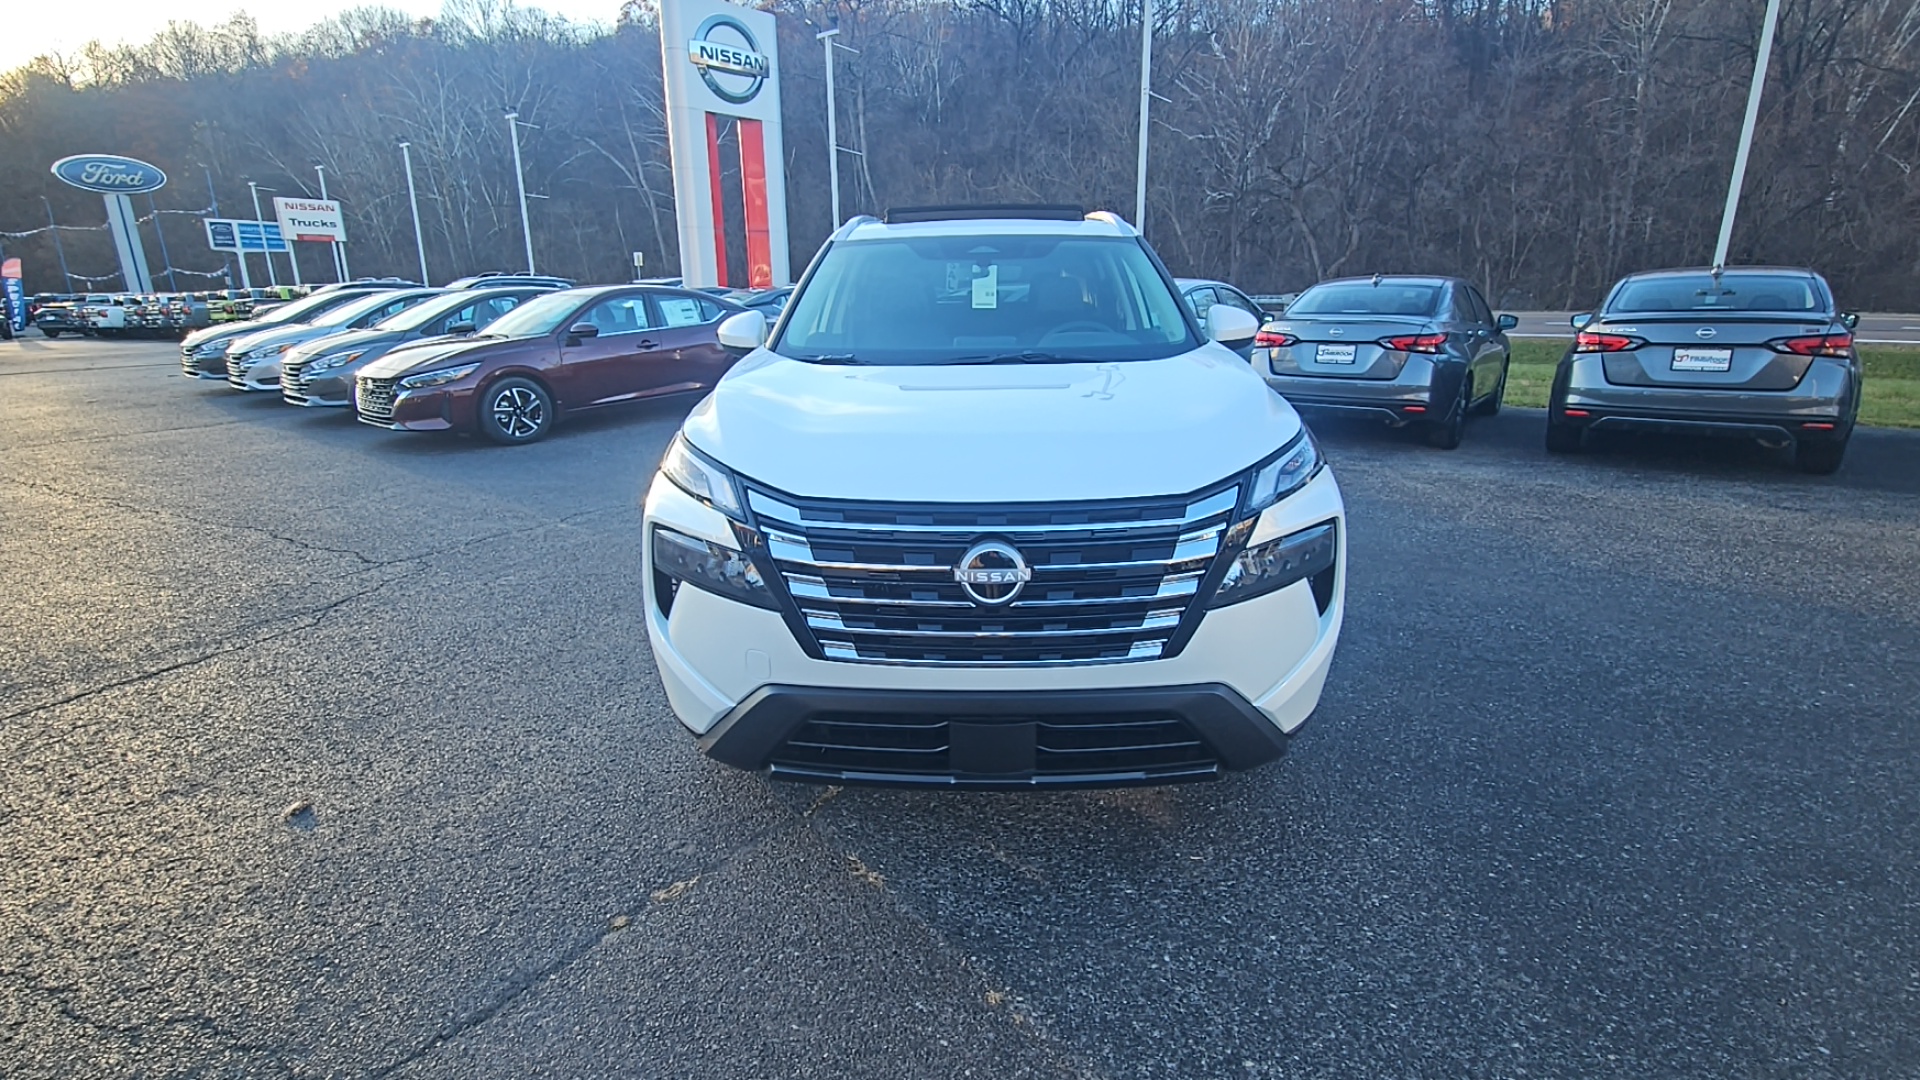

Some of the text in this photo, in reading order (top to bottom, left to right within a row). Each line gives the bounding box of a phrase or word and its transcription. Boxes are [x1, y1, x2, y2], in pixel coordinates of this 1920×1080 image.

[700, 45, 764, 71] NISSAN
[81, 162, 144, 186] Ford
[284, 202, 335, 212] NISSAN
[288, 217, 337, 229] Trucks
[955, 571, 1030, 582] NISSAN
